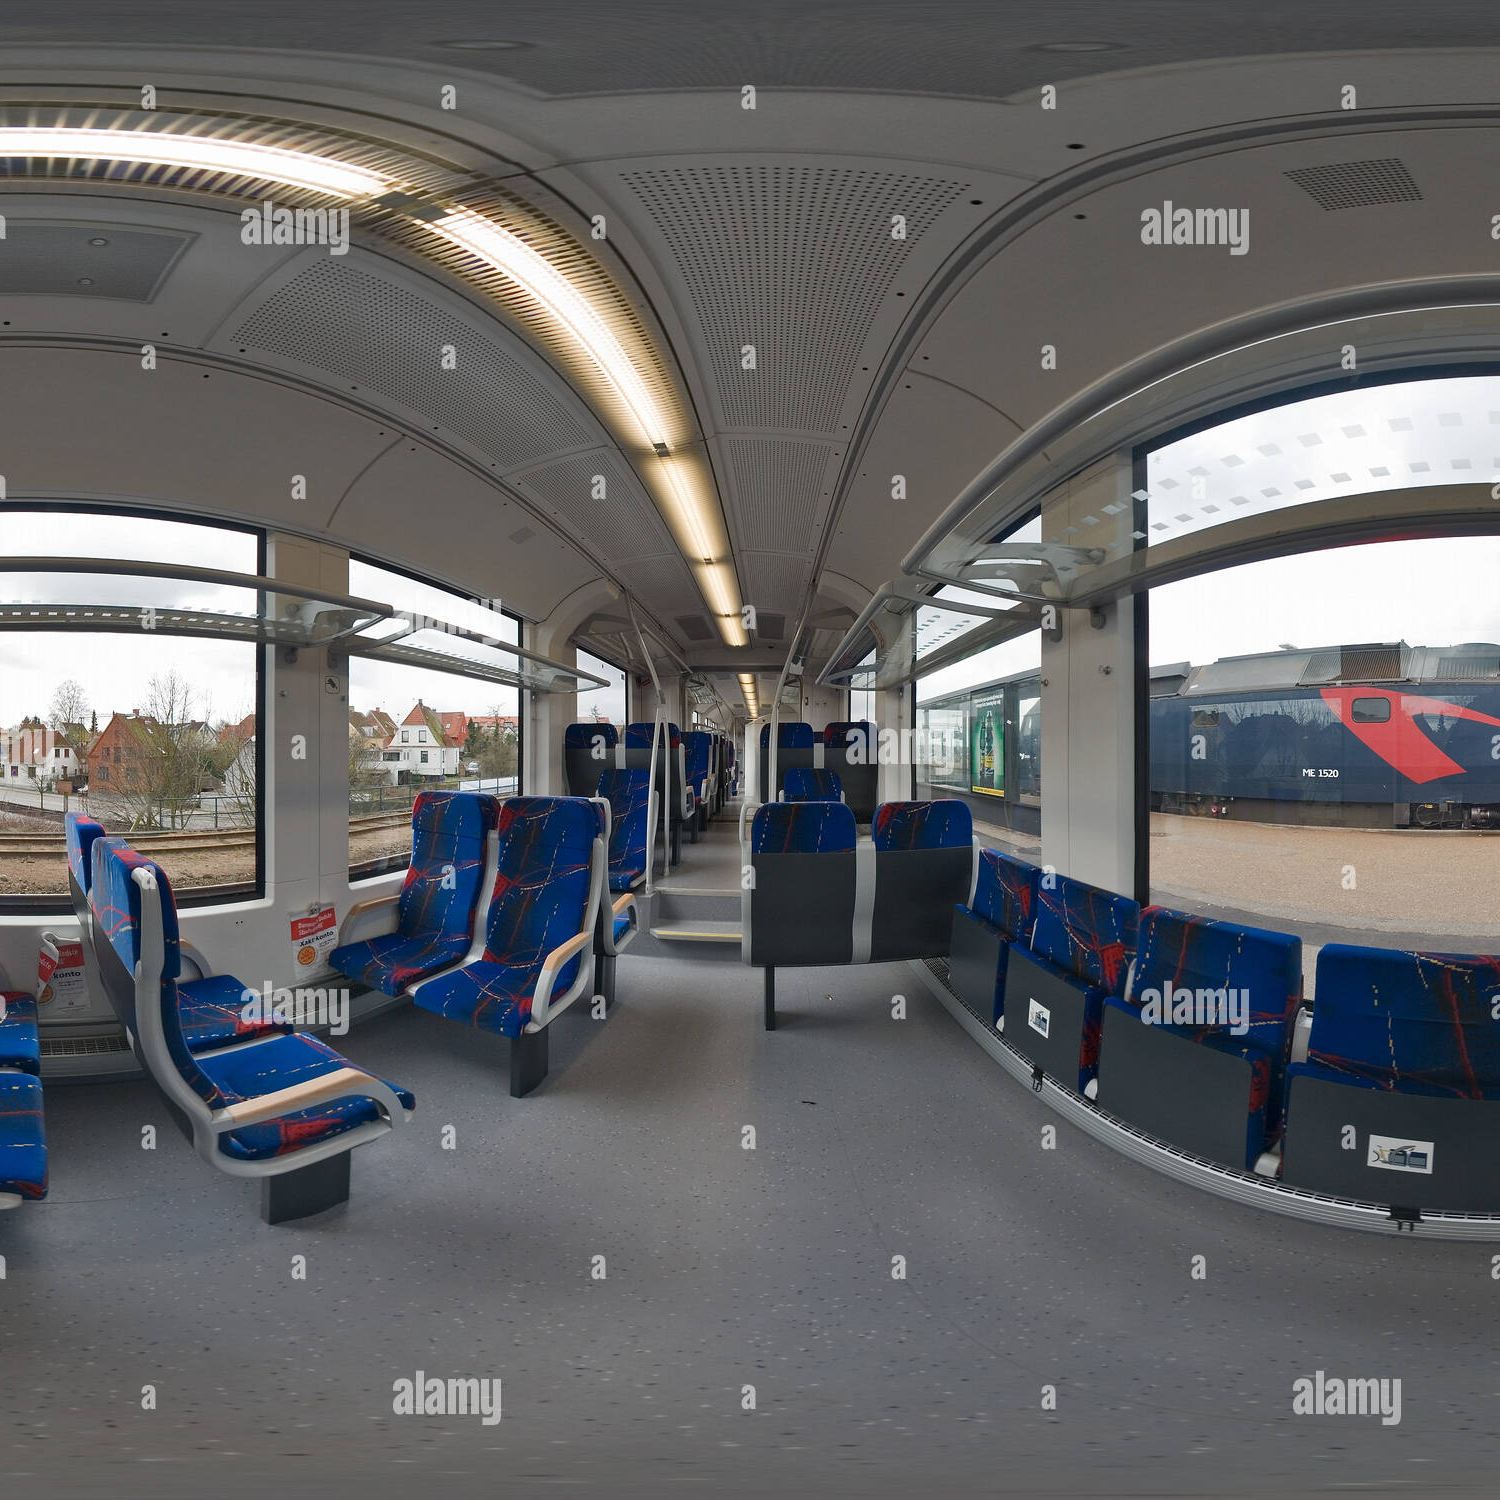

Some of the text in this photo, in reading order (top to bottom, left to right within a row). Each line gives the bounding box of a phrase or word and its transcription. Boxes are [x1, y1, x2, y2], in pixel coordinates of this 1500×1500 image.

[1302, 768, 1339, 778] ME 1520
[315, 930, 334, 942] konto
[53, 970, 81, 980] konto
